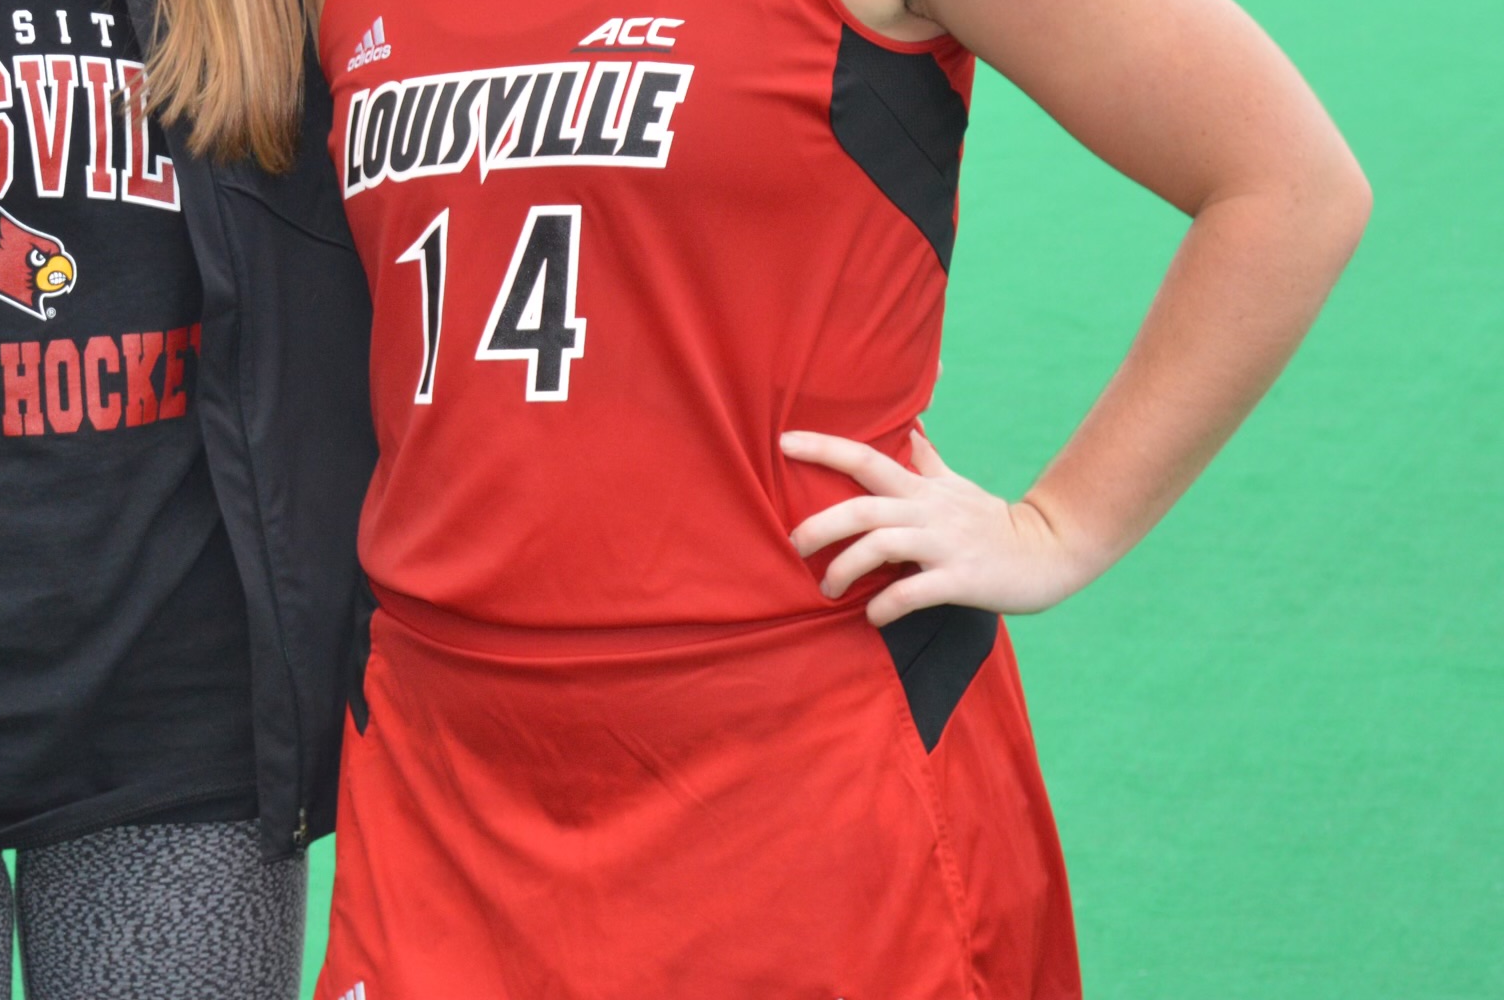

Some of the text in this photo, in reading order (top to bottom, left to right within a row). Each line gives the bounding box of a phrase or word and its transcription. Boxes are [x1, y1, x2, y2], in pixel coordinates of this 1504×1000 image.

[347, 44, 392, 73] adidas
[577, 16, 686, 48] ACC
[344, 61, 695, 200] LOUISVILLE
[395, 205, 588, 405] 14
[0, 322, 203, 437] HOCKE
